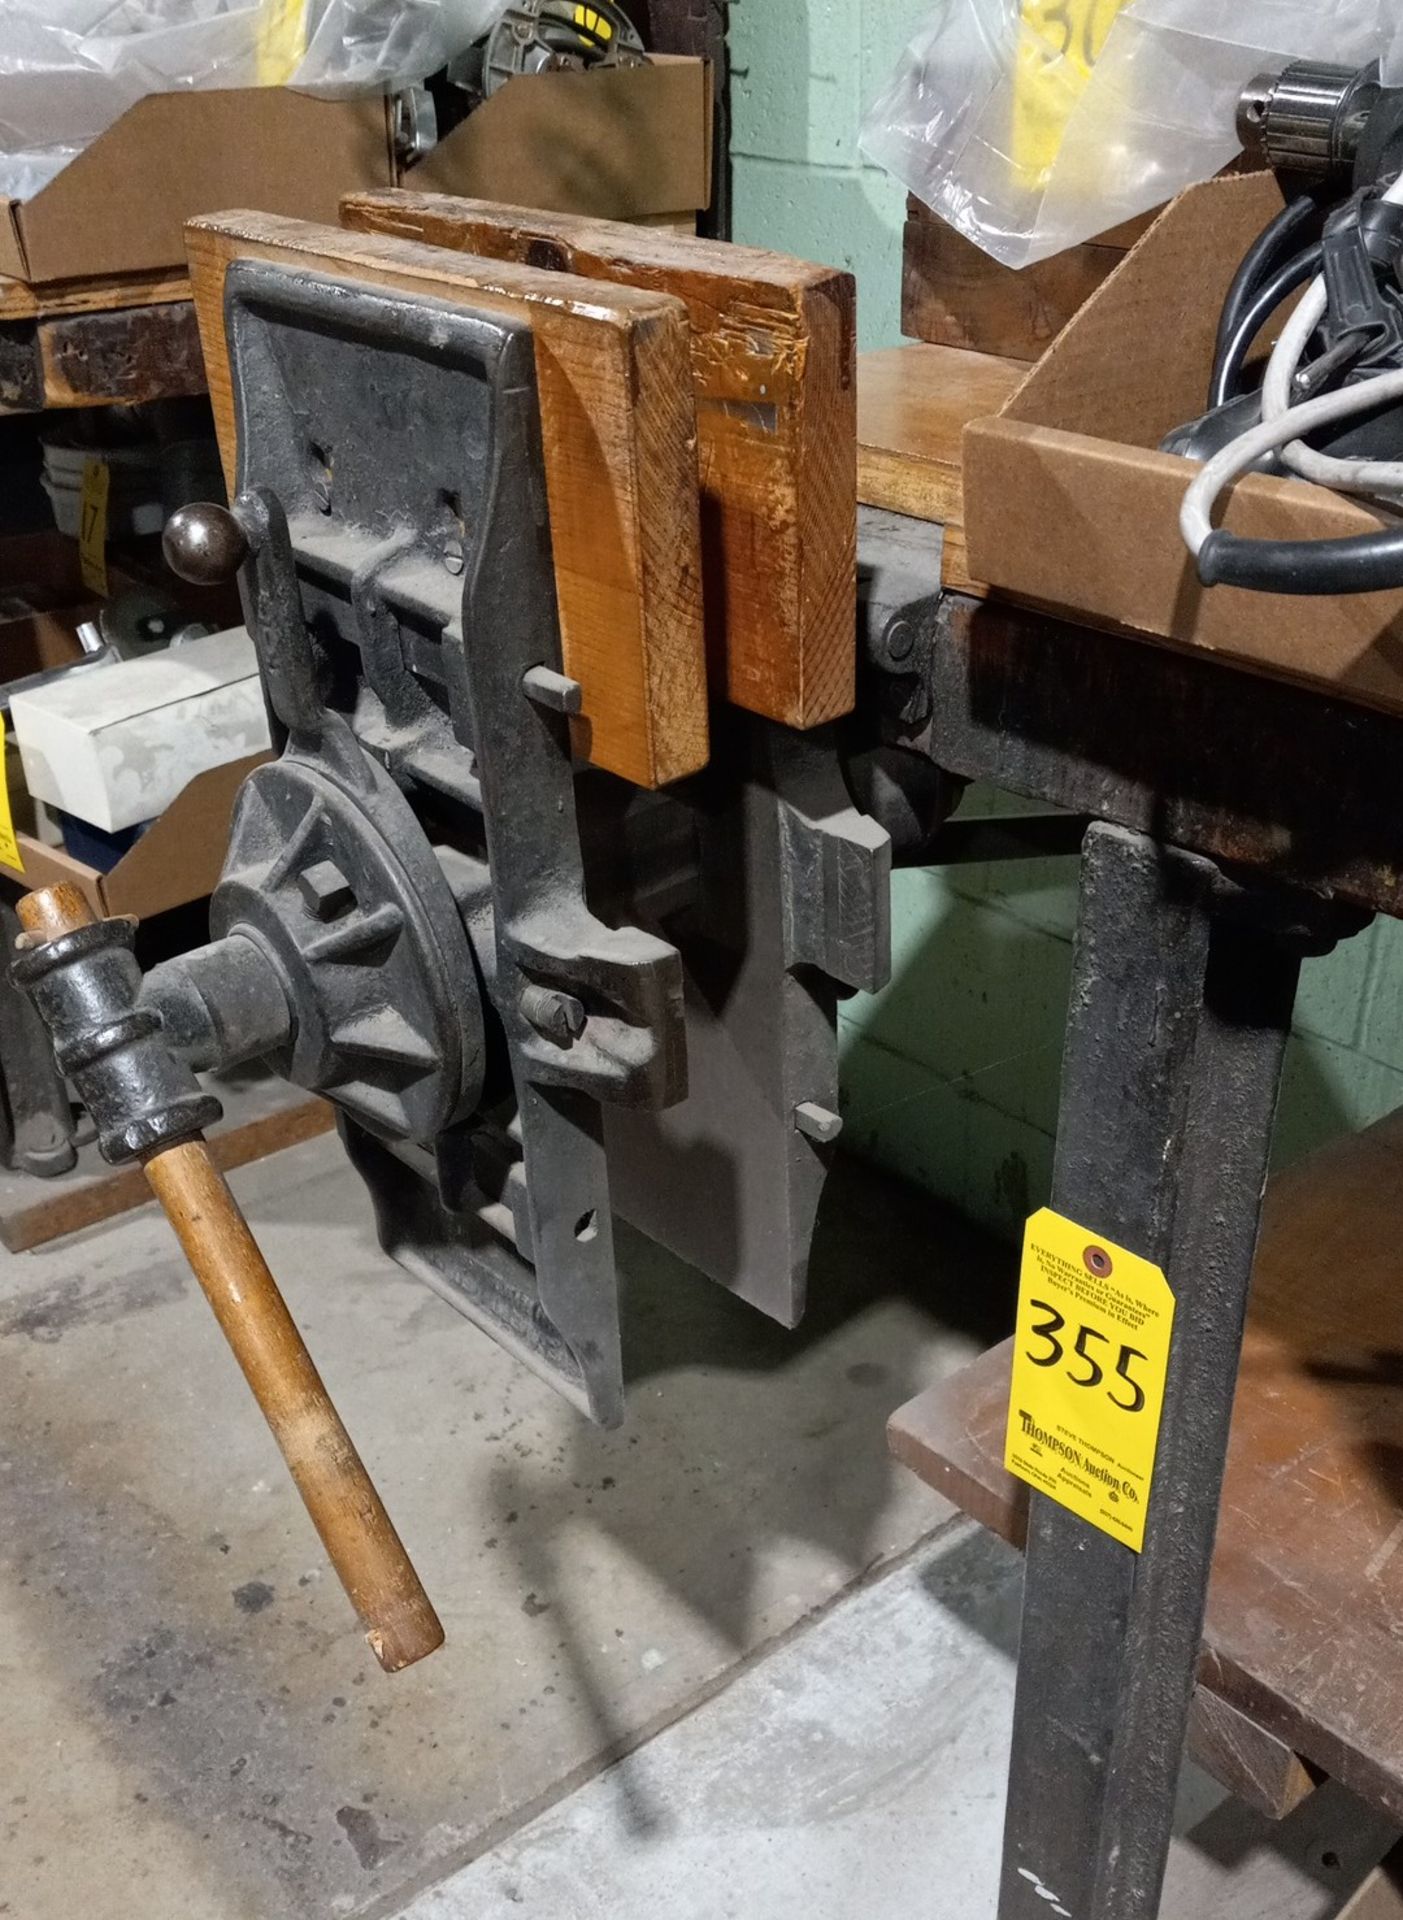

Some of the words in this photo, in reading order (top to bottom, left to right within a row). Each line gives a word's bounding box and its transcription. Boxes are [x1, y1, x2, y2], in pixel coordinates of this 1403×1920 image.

[1031, 1243, 1083, 1276] EVERYTHING
[1084, 1272, 1109, 1291] SELLS
[1135, 1299, 1159, 1318] Where
[1041, 1264, 1074, 1287] INSPECT
[1075, 1284, 1107, 1307] BEFORE
[1109, 1302, 1128, 1316] YOU
[1129, 1313, 1144, 1326] BID
[1048, 1276, 1074, 1296] Buyer's
[1075, 1292, 1106, 1314] Premium
[1117, 1315, 1138, 1331] Effect
[1057, 1265, 1094, 1291] Warranties
[1026, 1298, 1149, 1413] 355
[1056, 1425, 1077, 1441] STEVE
[1078, 1438, 1115, 1464] THOMPSON
[1083, 1457, 1120, 1493] Auction
